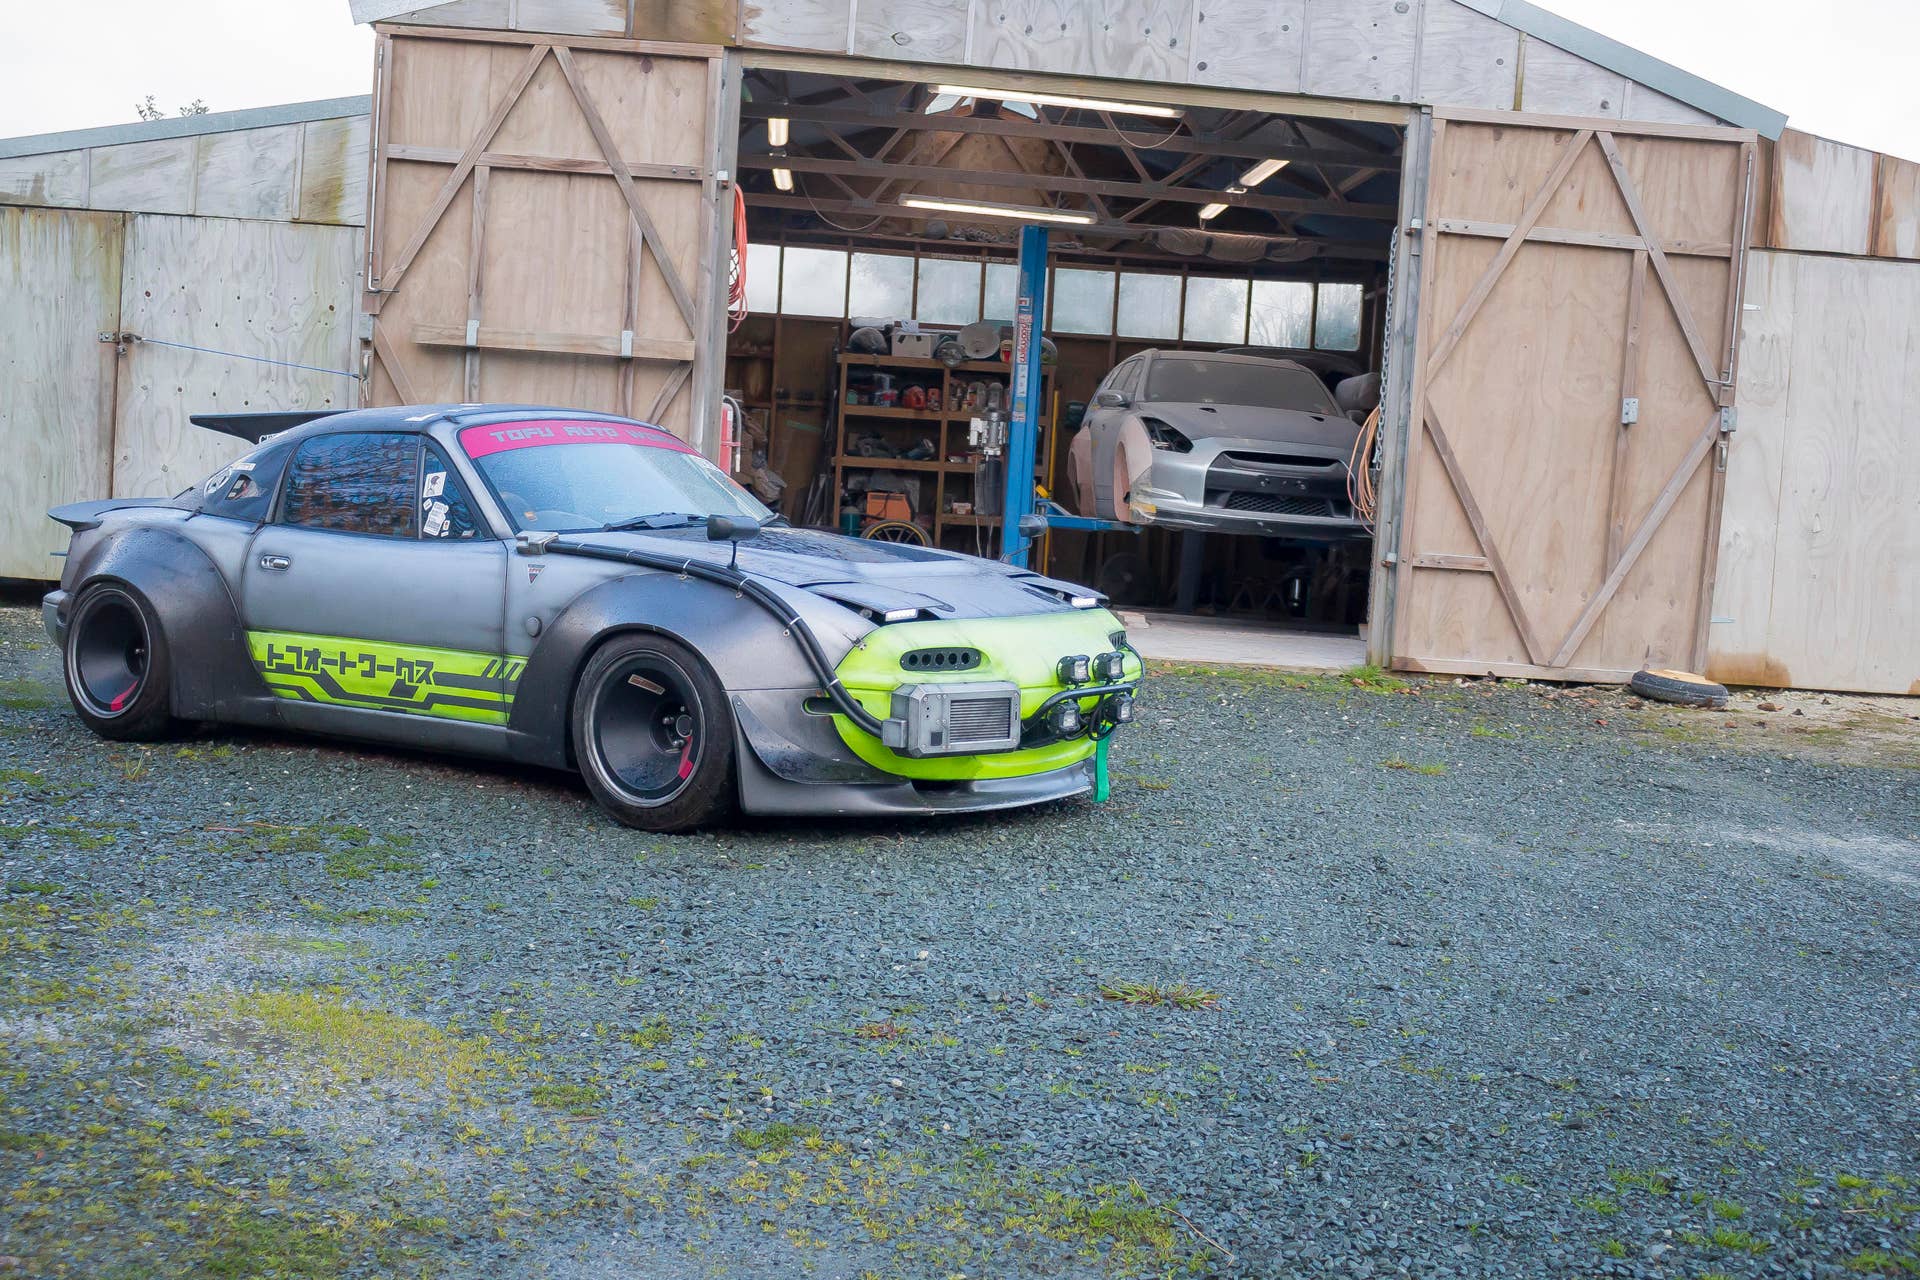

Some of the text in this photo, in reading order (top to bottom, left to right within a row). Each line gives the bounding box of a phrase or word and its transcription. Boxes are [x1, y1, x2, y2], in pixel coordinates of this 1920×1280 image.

[489, 426, 681, 445] TOFU AUTO WOR
